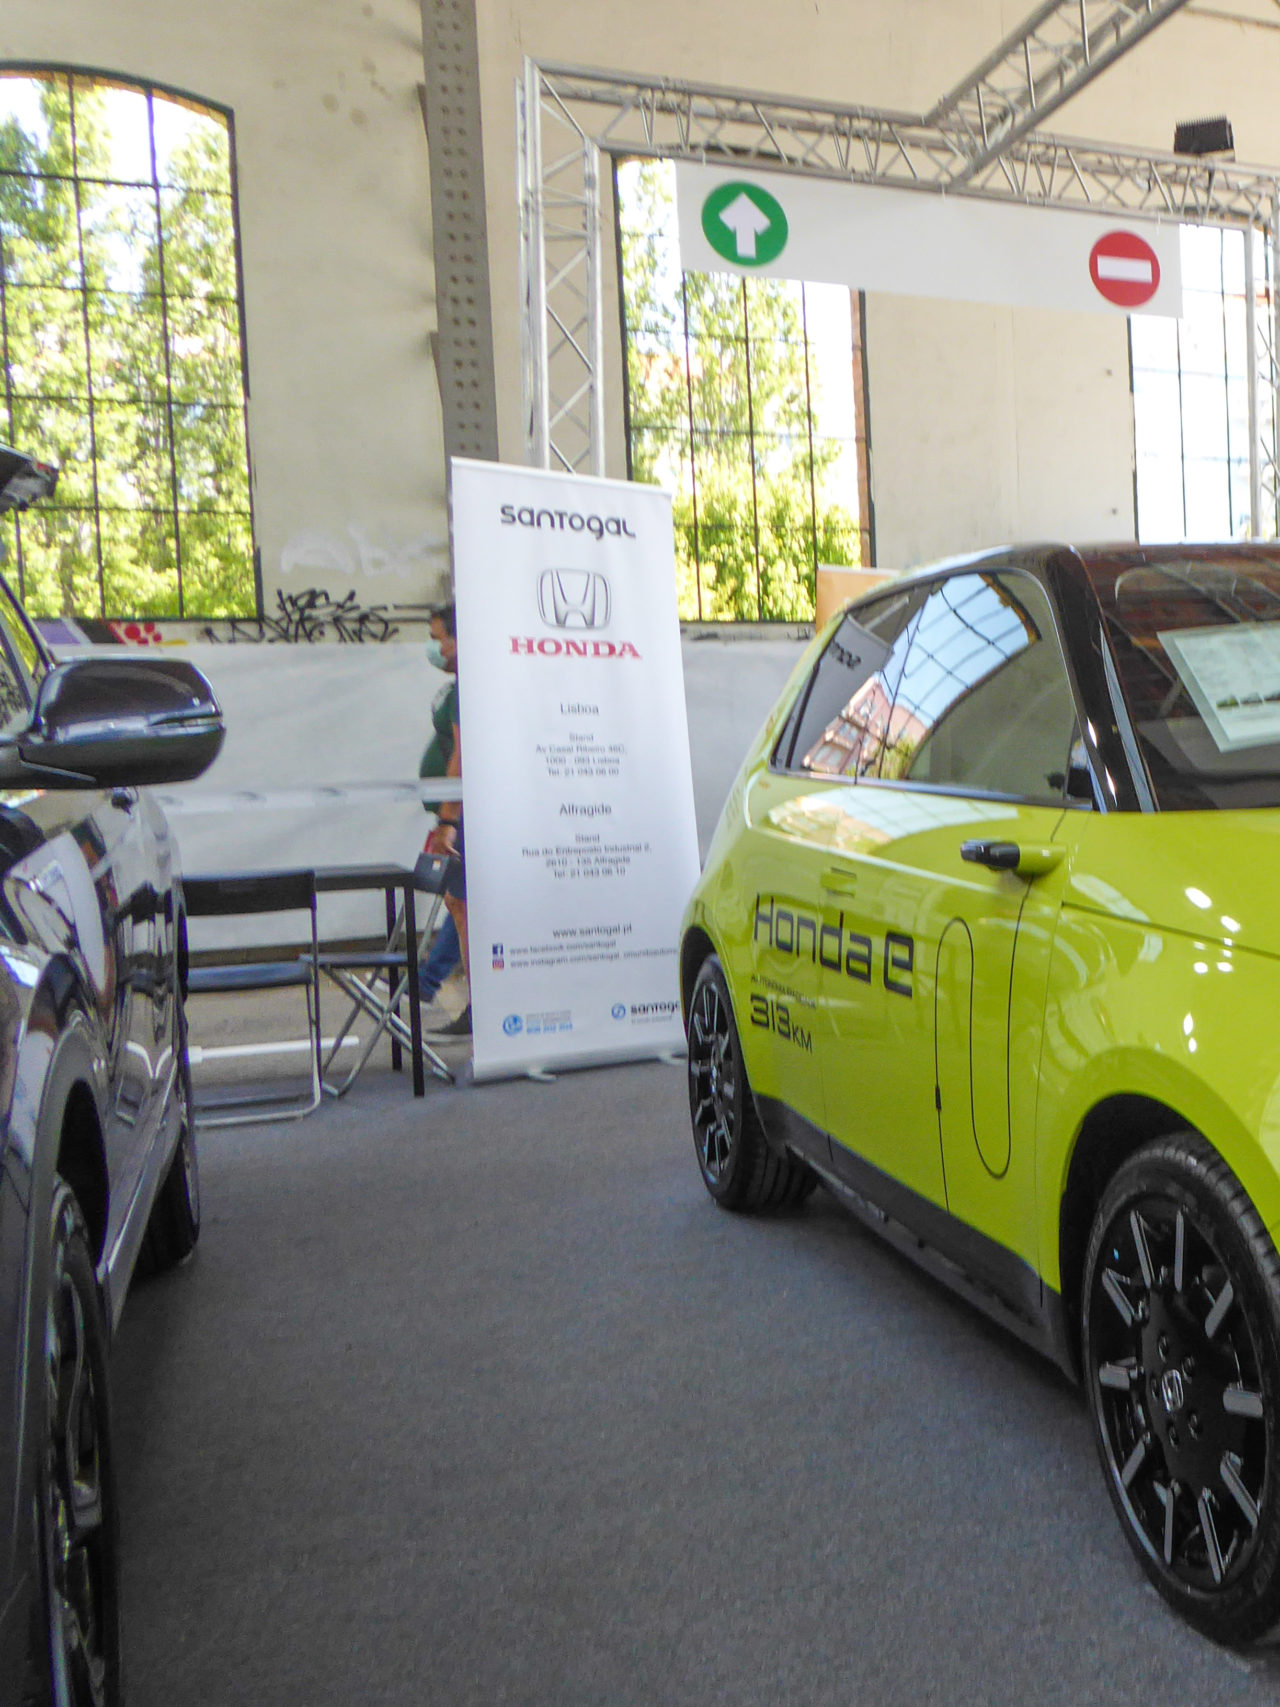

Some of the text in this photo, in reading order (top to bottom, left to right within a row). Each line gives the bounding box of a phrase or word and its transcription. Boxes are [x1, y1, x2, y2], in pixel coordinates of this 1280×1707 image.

[500, 504, 636, 541] santogal
[508, 635, 642, 660] HONDA
[560, 702, 600, 716] Lisboa
[559, 802, 612, 818] Alfragide
[754, 892, 914, 999] Honda e
